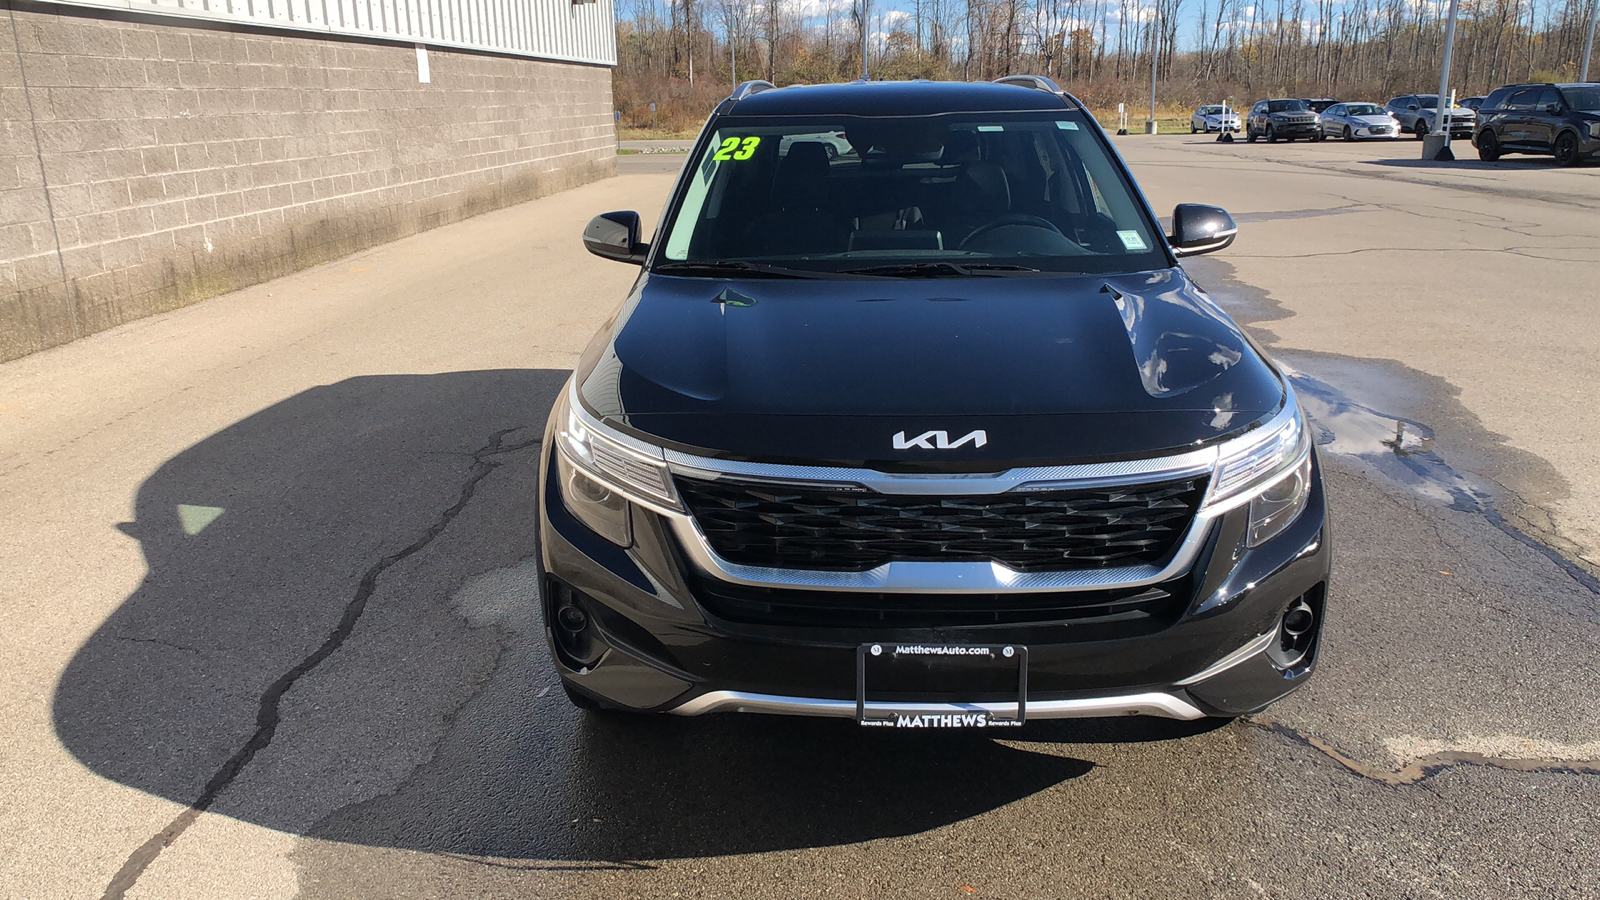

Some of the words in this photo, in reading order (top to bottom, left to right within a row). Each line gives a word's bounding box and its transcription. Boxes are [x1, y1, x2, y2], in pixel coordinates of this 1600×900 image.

[713, 136, 761, 161] 23
[892, 430, 987, 449] KIA
[895, 645, 990, 655] MatthewsAuto.com
[896, 714, 987, 728] MATTHEWS
